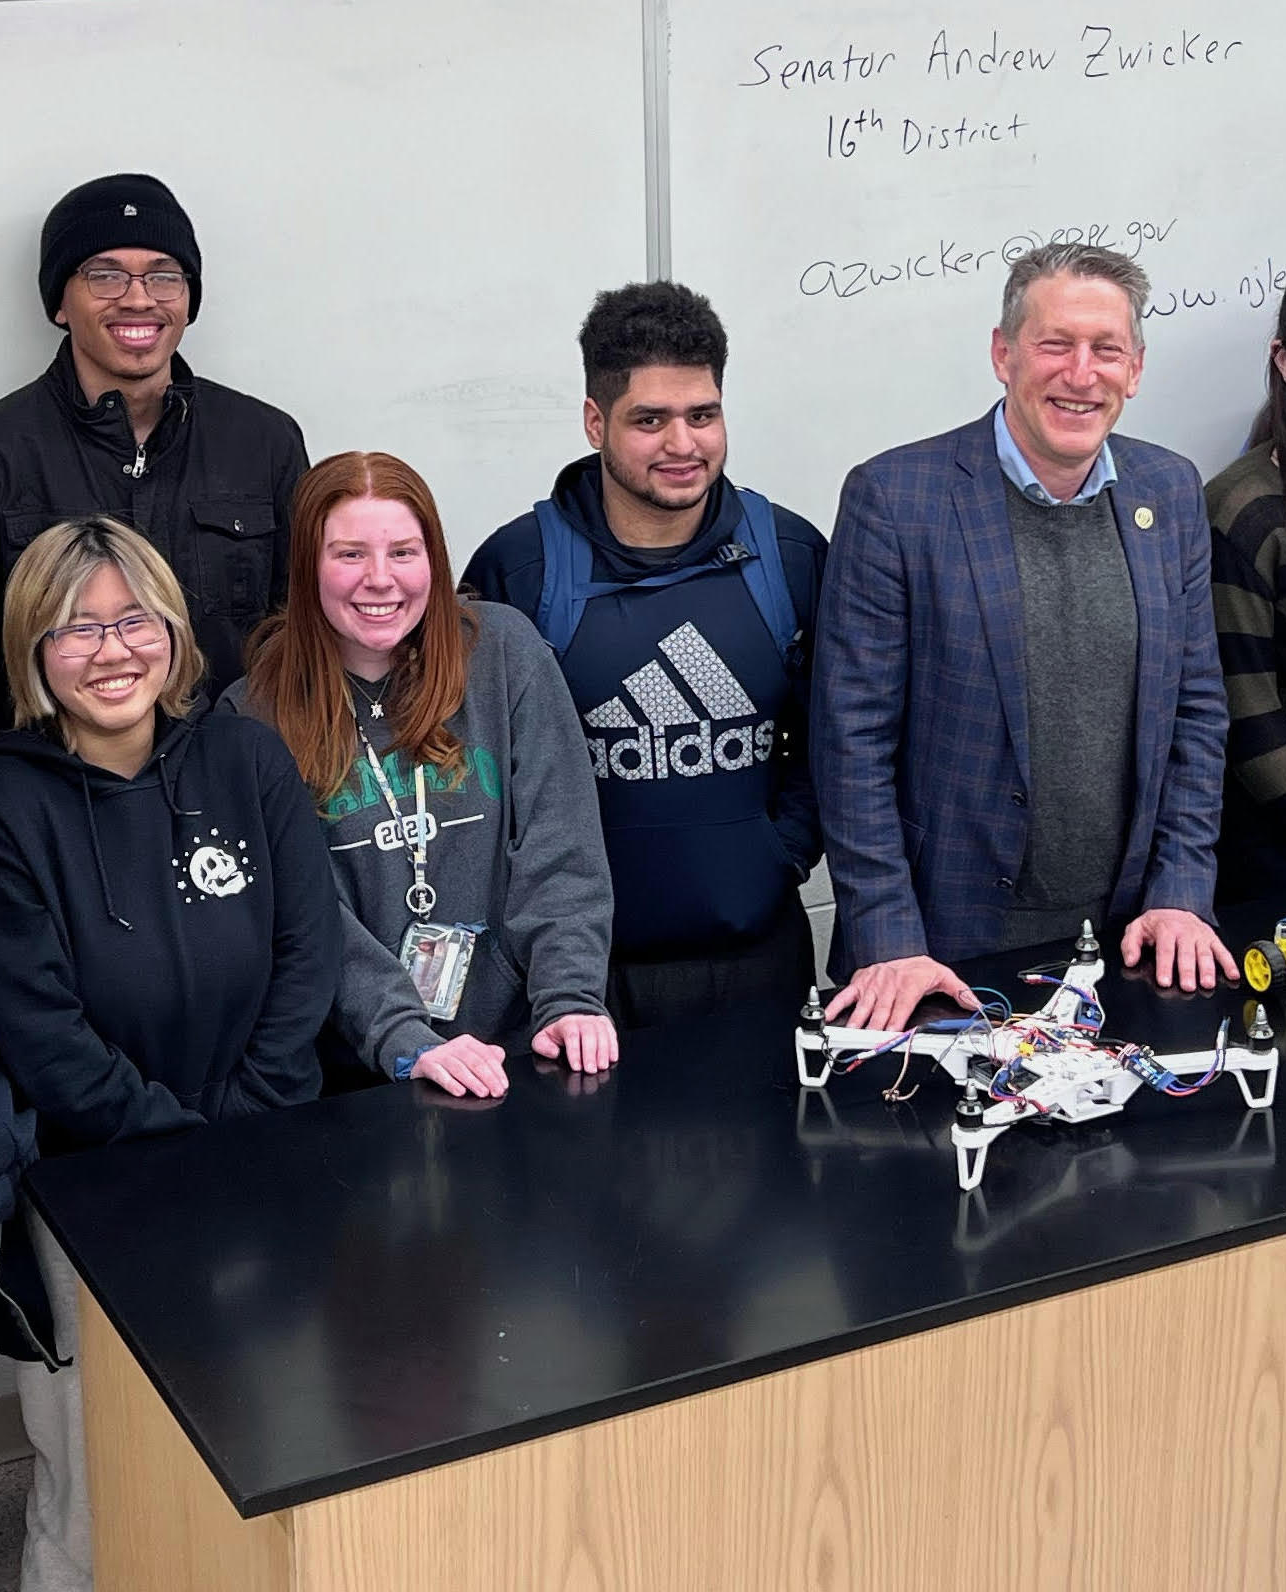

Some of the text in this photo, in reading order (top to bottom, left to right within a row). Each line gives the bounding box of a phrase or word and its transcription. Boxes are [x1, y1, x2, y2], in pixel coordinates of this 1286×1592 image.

[738, 25, 1244, 89] Senator Andrew Zwicker
[827, 108, 1031, 158] 16th District
